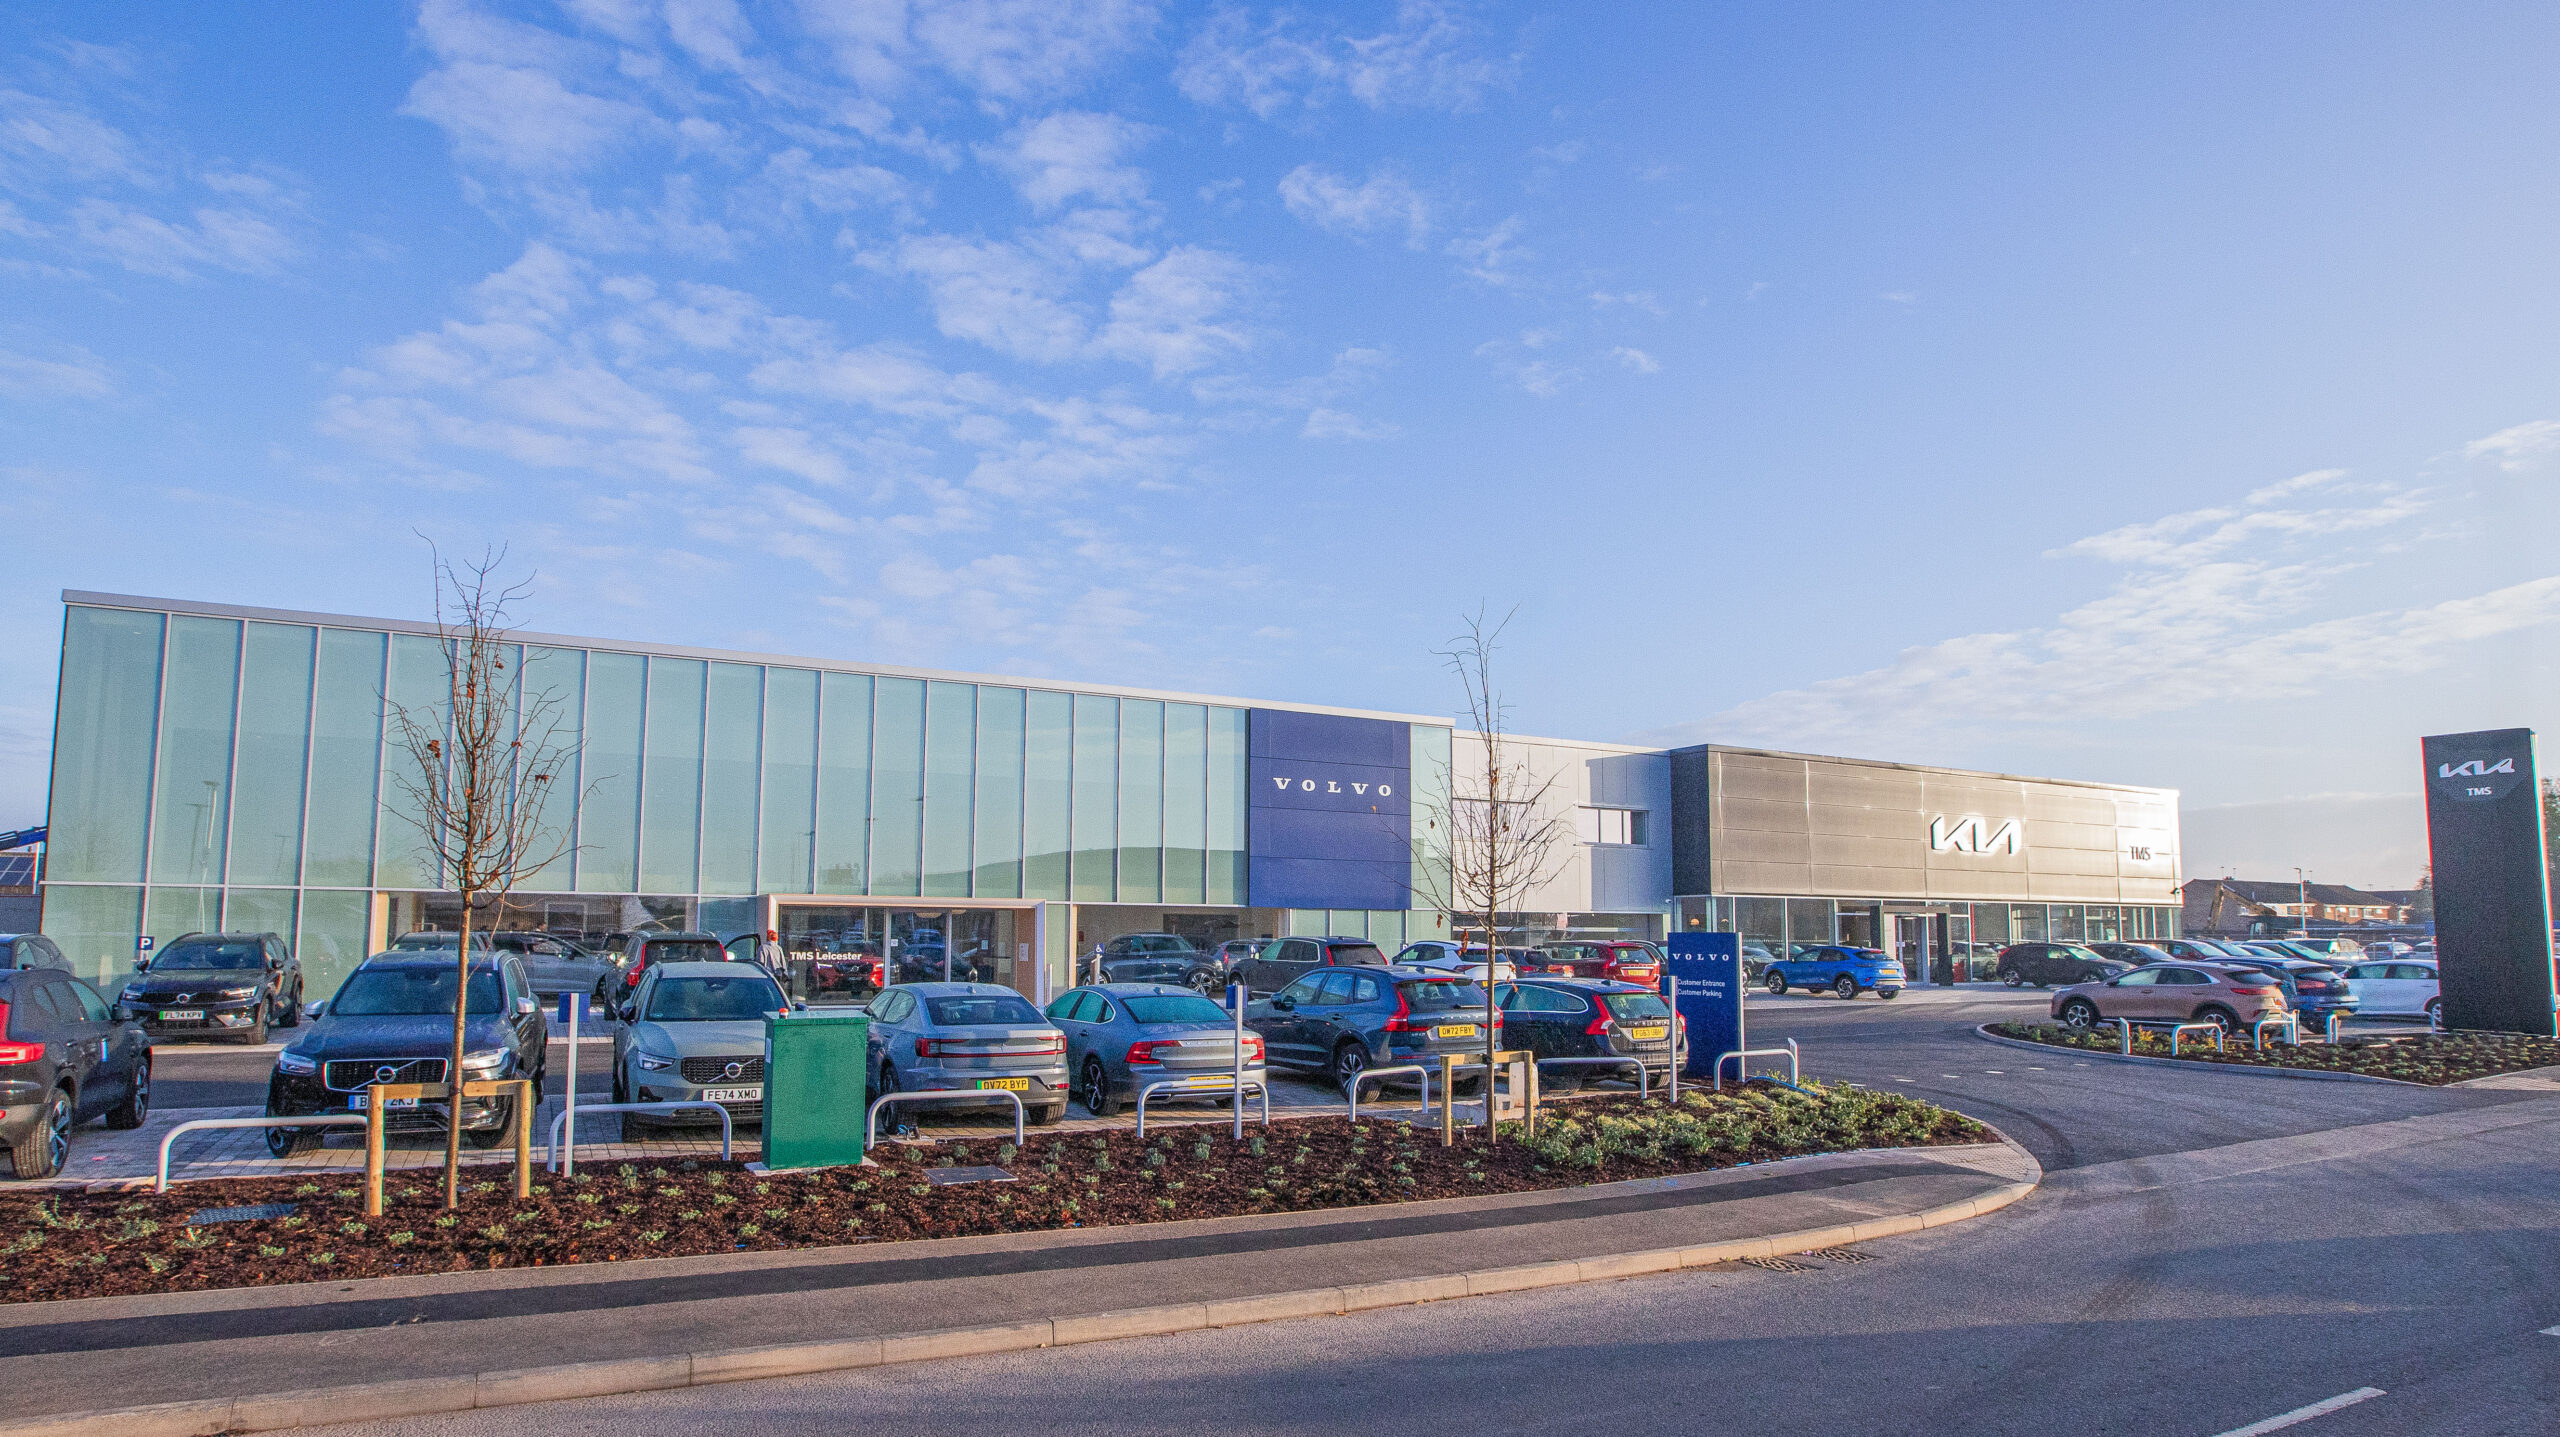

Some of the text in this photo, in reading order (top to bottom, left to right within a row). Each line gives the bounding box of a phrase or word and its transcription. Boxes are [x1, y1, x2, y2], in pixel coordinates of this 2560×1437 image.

[2439, 758, 2515, 778] KIA
[1273, 777, 1392, 797] VOLVO
[2466, 786, 2493, 796] TMS
[1930, 815, 2020, 856] KIA
[2129, 846, 2151, 861] TMS
[141, 937, 152, 949] P
[790, 952, 862, 960] TMS Leicester
[1672, 953, 1730, 962] VOLVO
[1702, 990, 1722, 999] Parking
[1010, 1080, 1027, 1088] BYP
[707, 1089, 757, 1100] FE74 XMO
